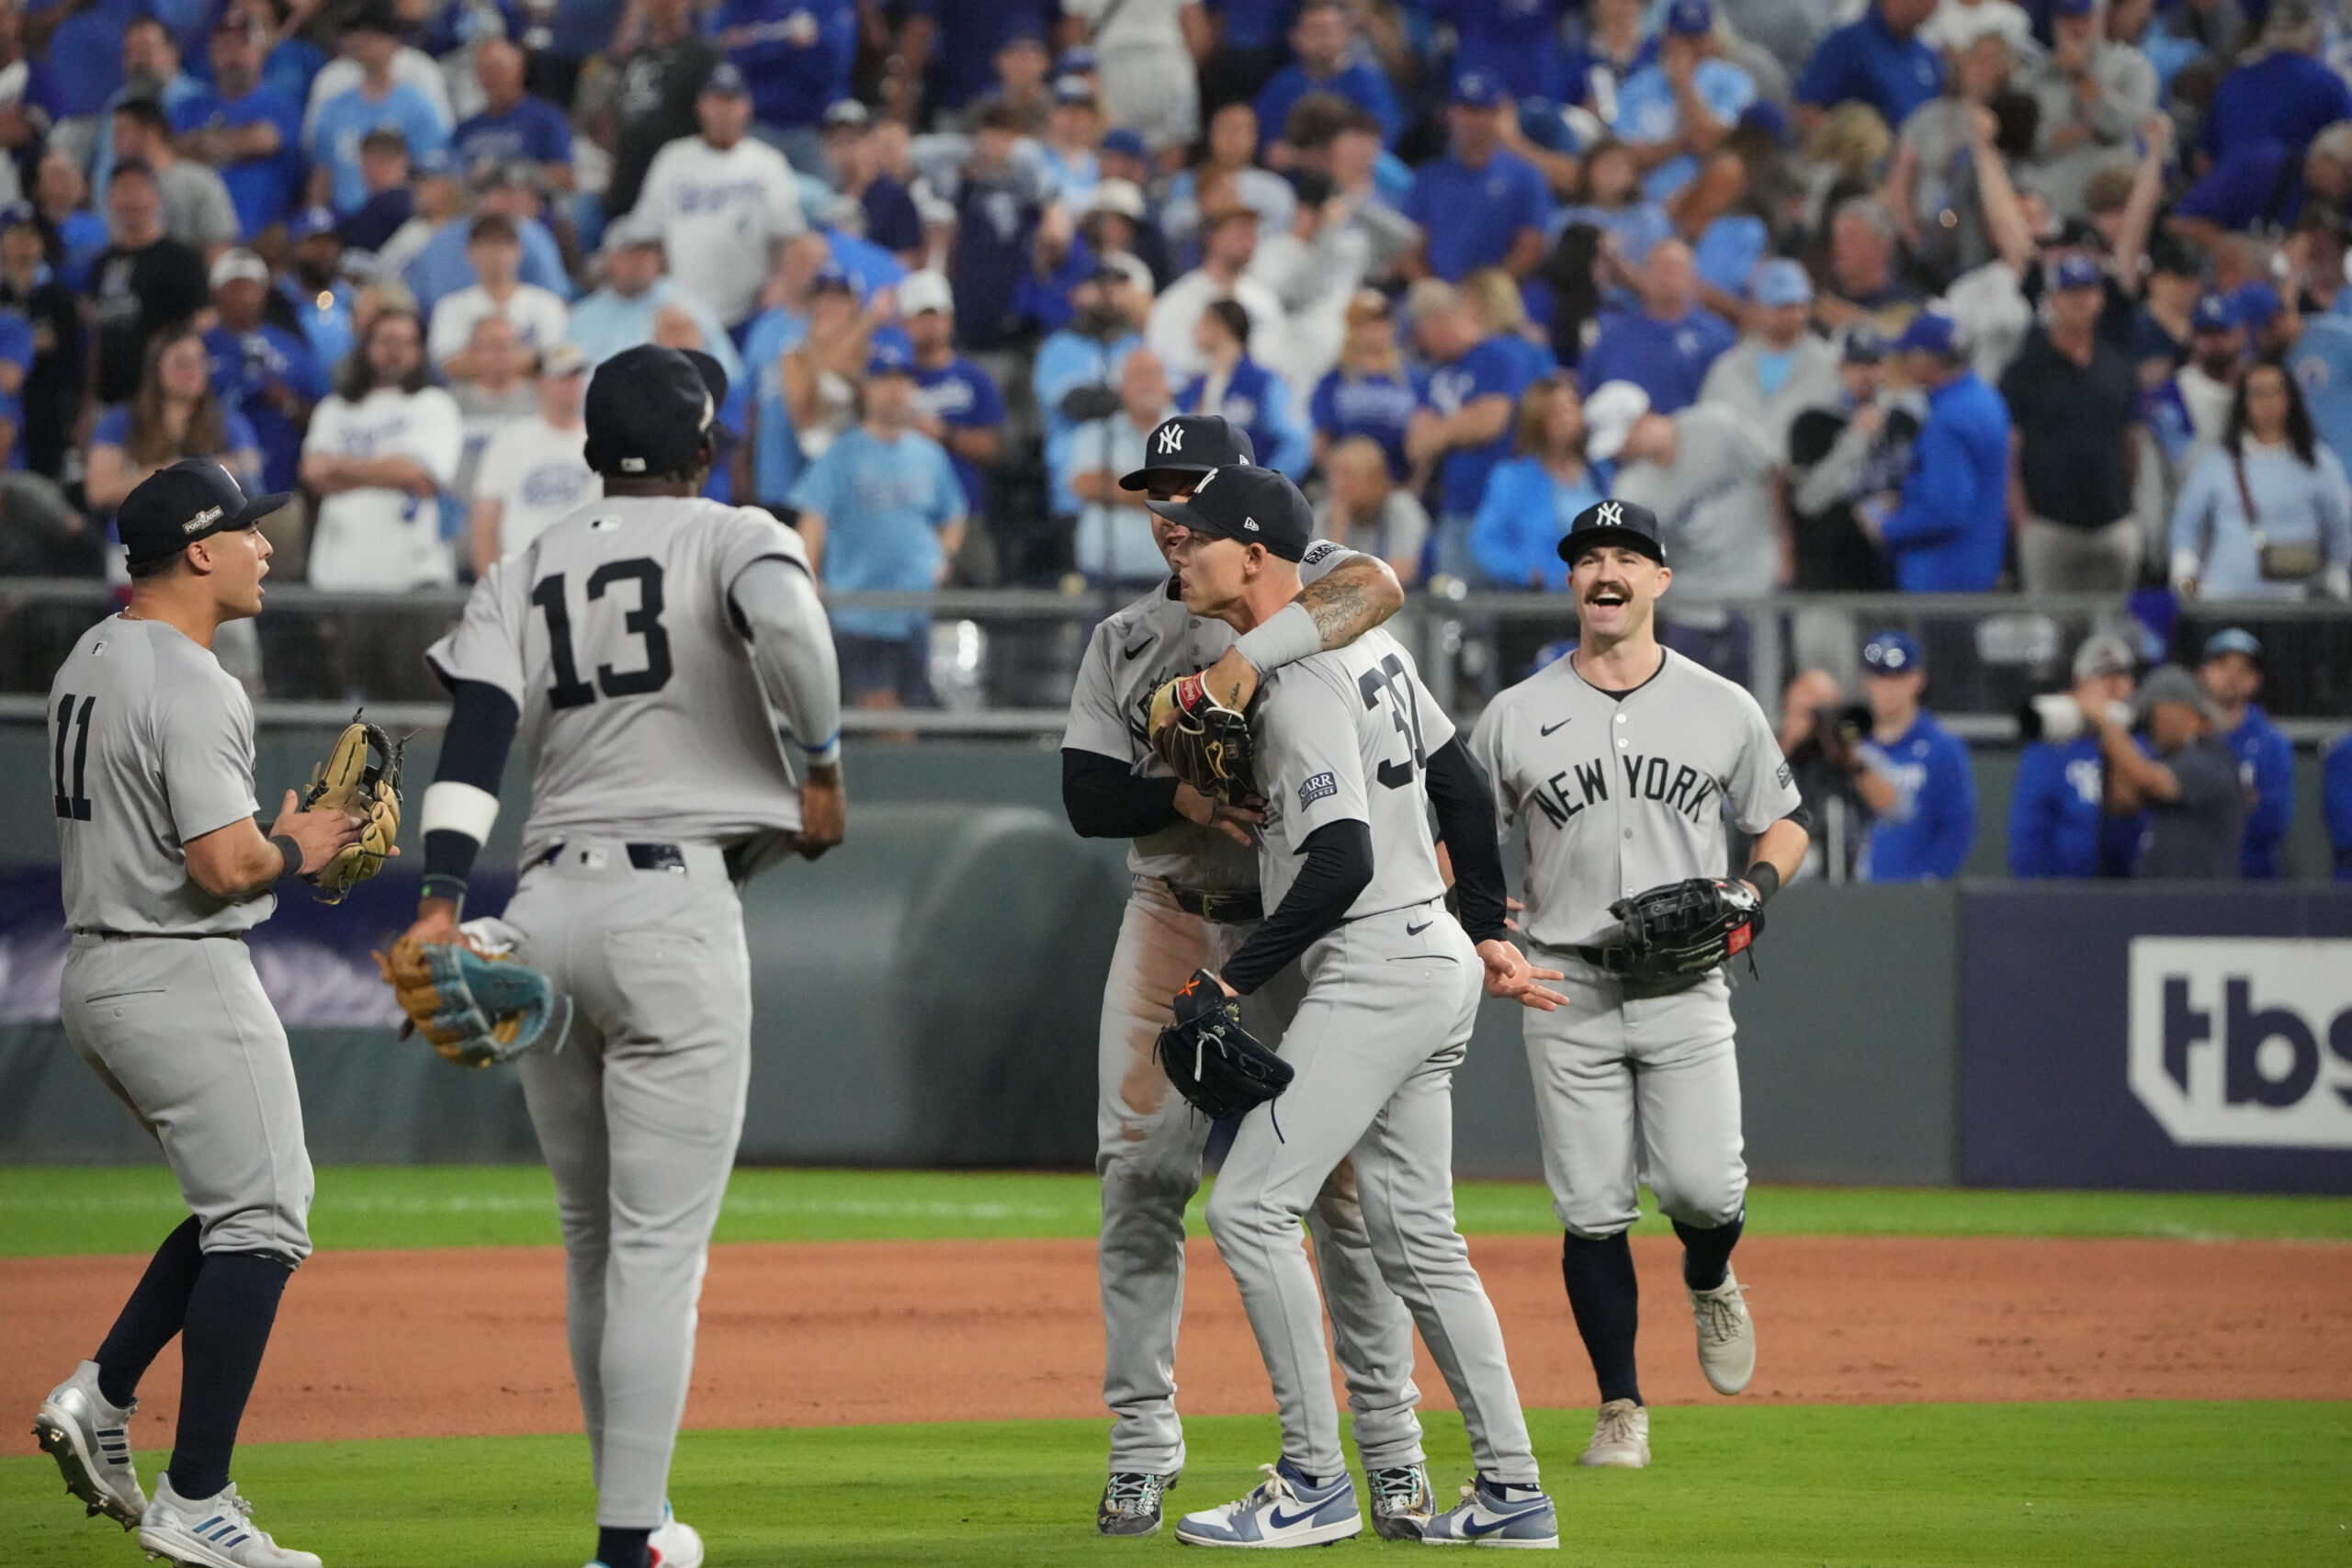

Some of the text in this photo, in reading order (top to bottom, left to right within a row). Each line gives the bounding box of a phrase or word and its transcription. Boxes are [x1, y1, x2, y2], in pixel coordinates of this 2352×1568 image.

[1158, 423, 1185, 454] NY
[1596, 502, 1623, 526] NY
[532, 557, 673, 710] 13
[55, 693, 96, 822] 11
[1533, 754, 1715, 831] NEW YORK
